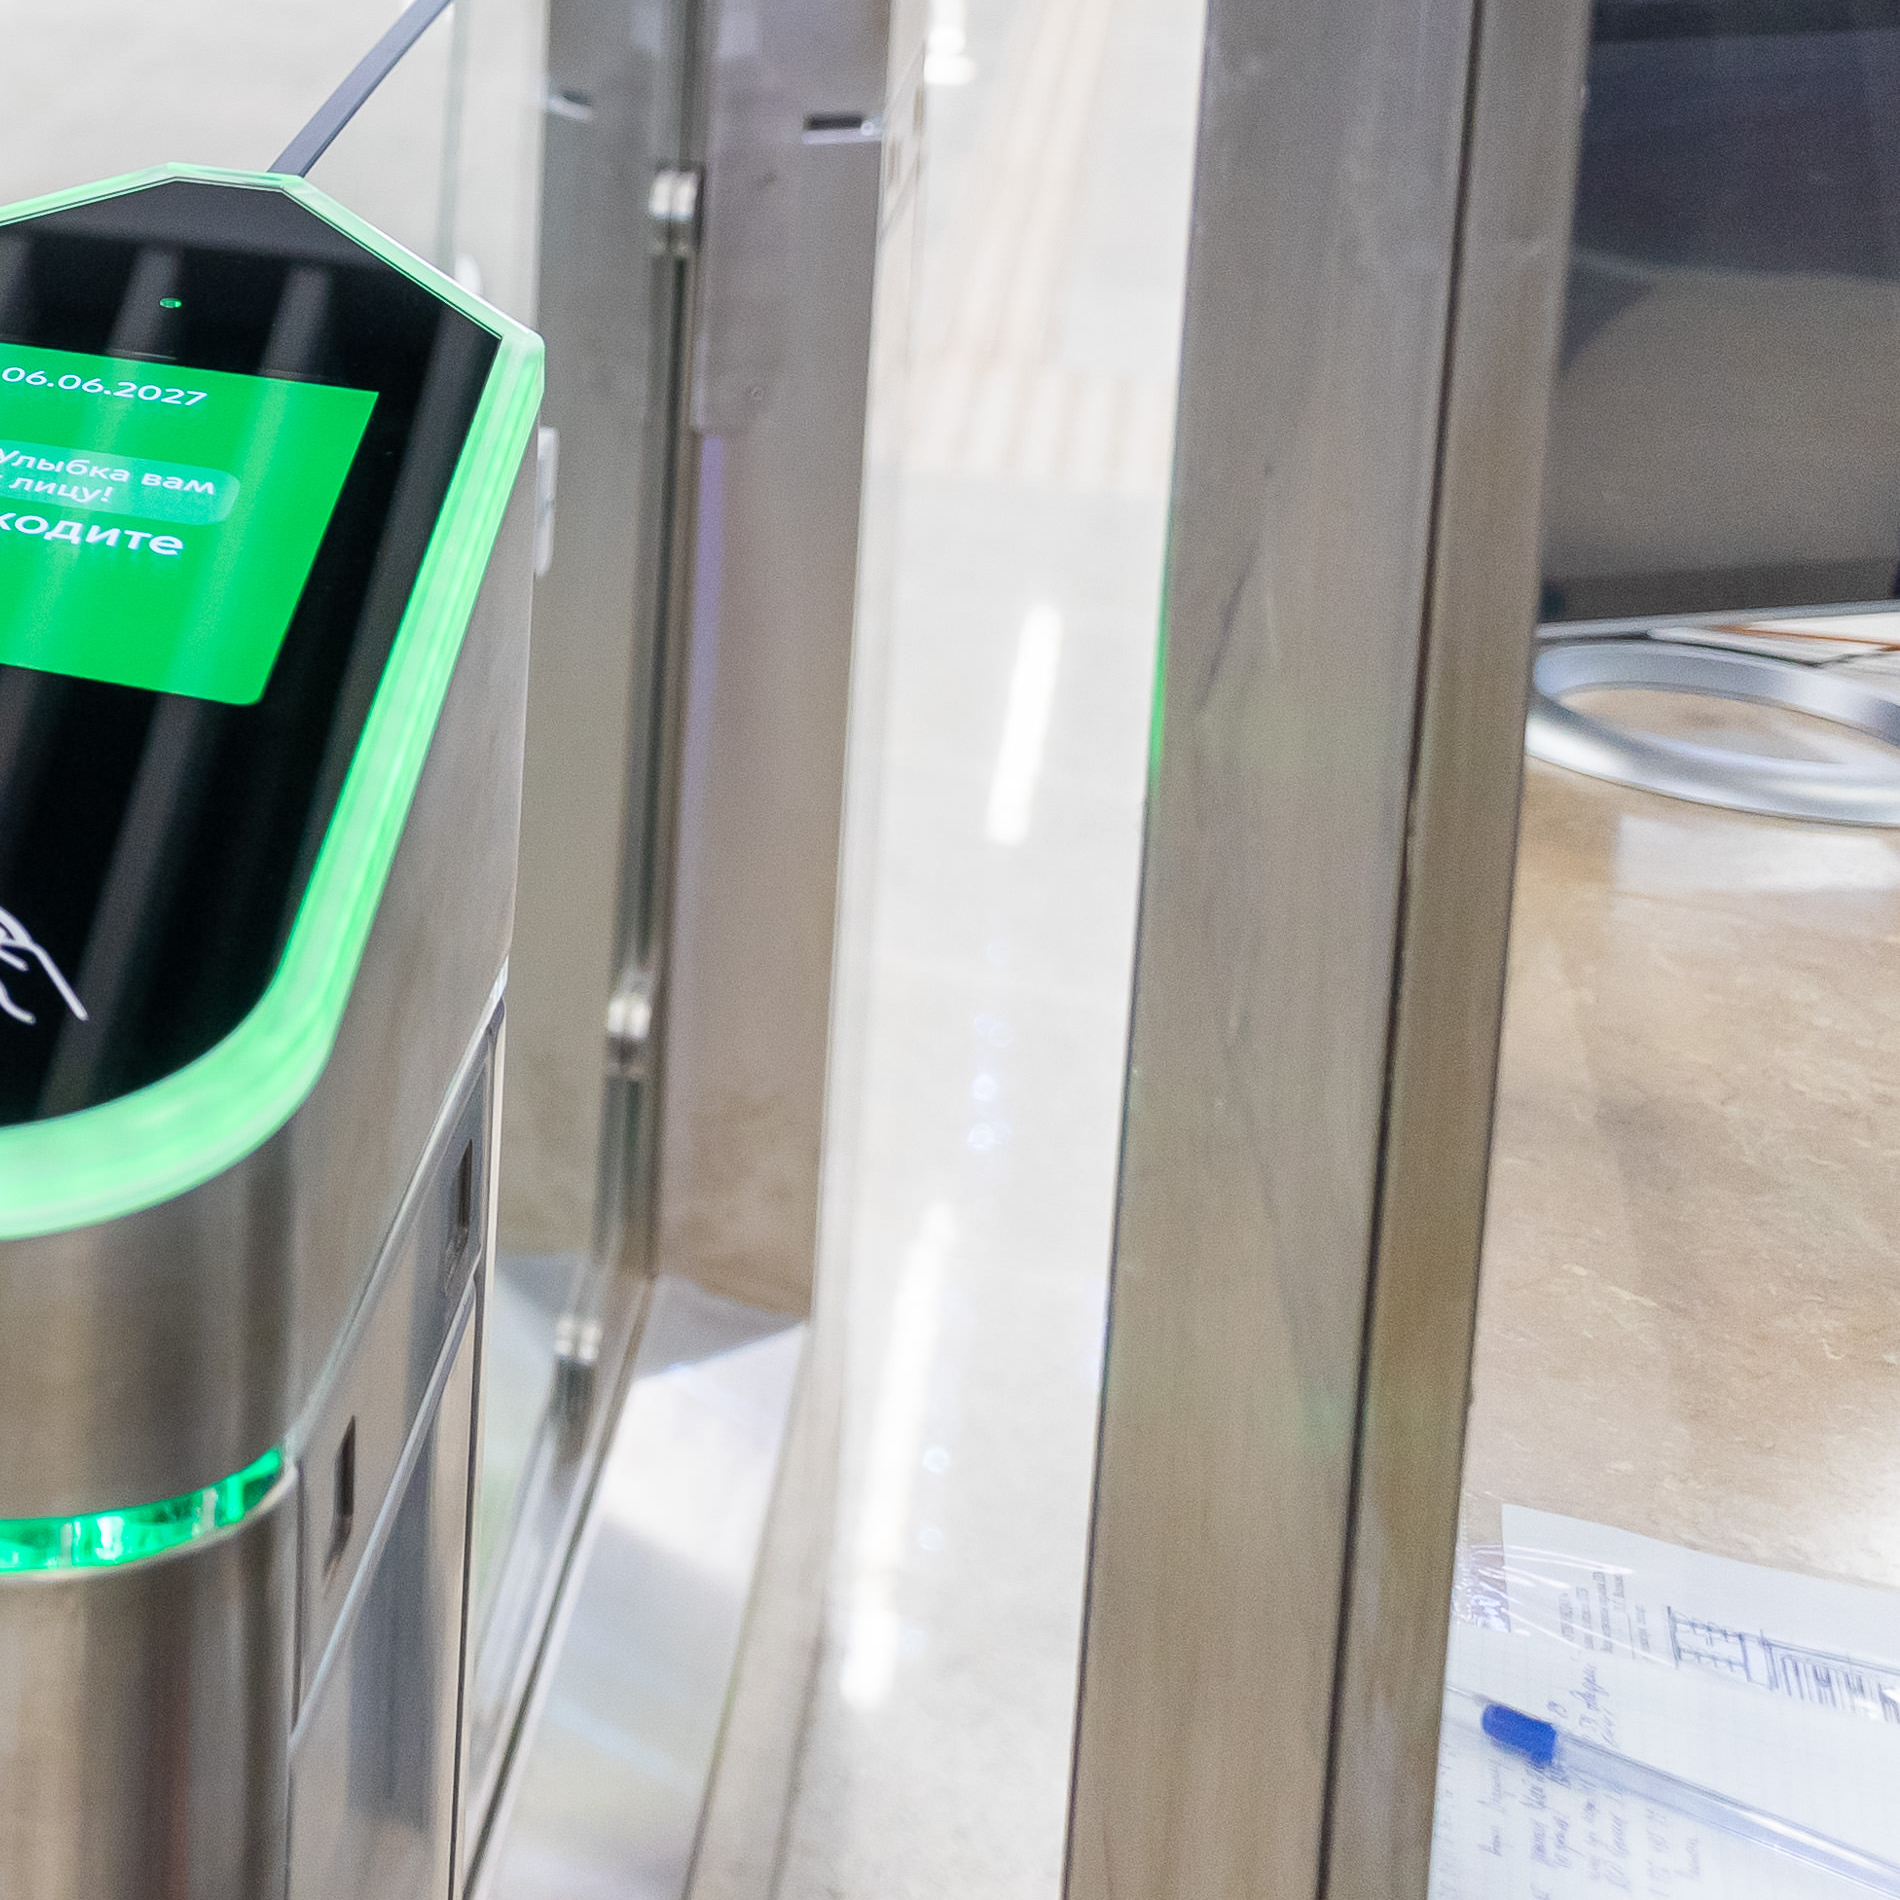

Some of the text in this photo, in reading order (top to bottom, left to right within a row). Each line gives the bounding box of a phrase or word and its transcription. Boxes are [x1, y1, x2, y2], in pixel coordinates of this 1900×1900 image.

[1, 366, 208, 407] 06.06.2027
[8, 475, 115, 504] лицу!
[141, 471, 216, 496] вам
